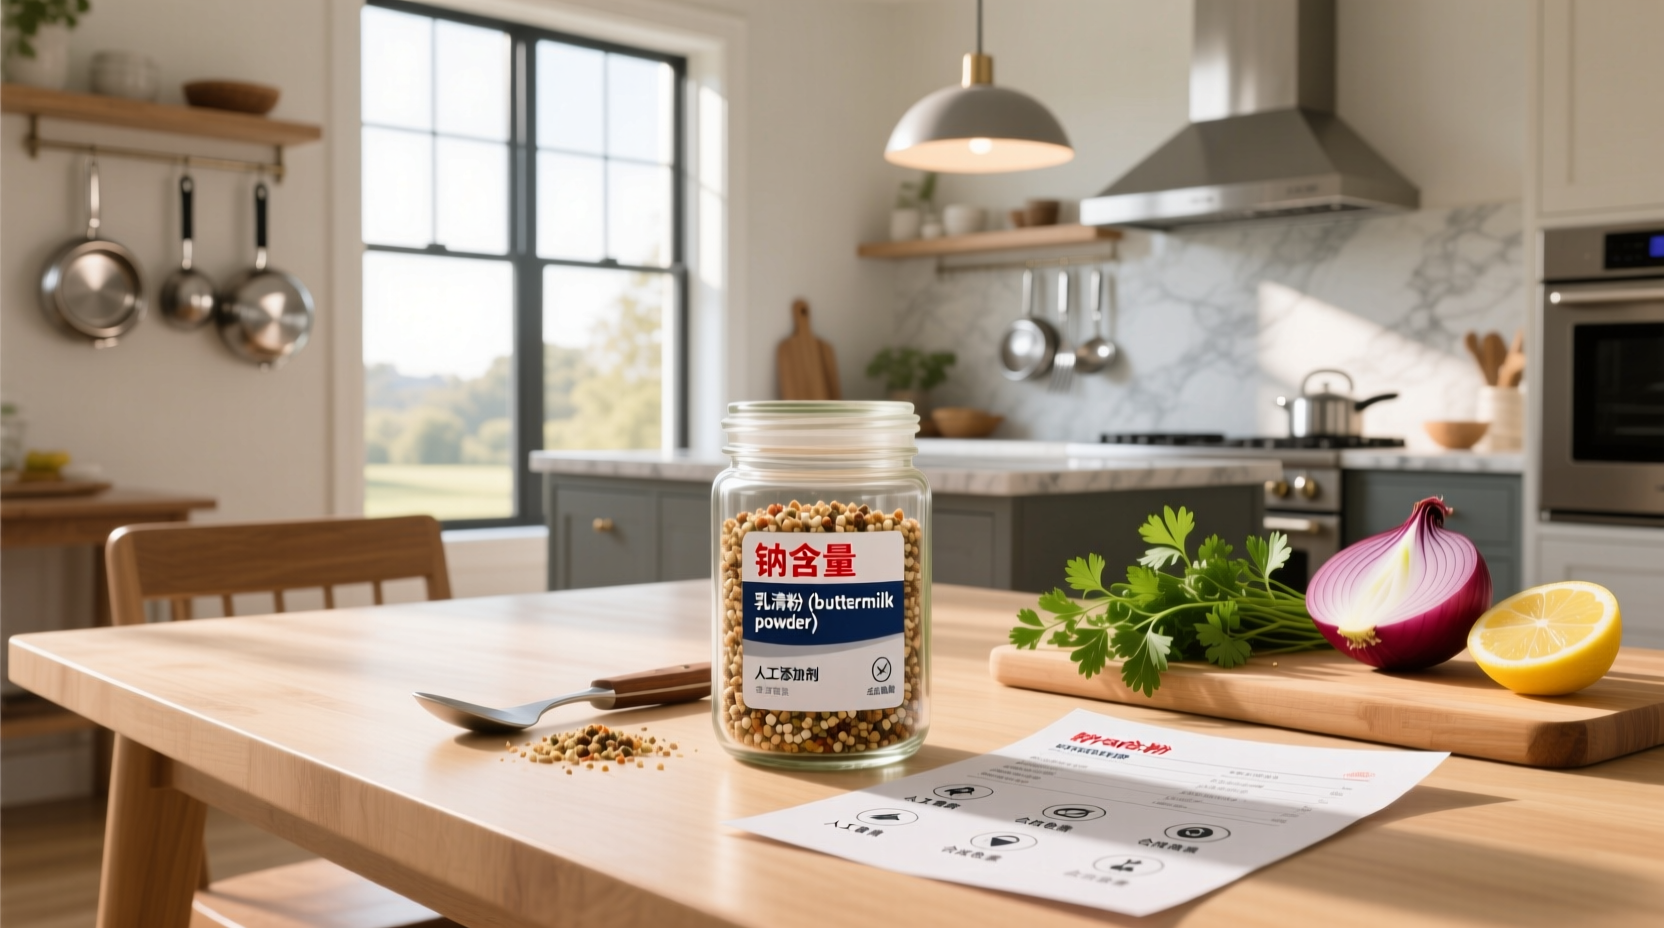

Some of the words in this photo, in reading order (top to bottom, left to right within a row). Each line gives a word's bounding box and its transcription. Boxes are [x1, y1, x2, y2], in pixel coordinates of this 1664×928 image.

[755, 542, 857, 578] 钠含量
[808, 591, 894, 613] (buttermilk
[755, 612, 818, 635] powder)
